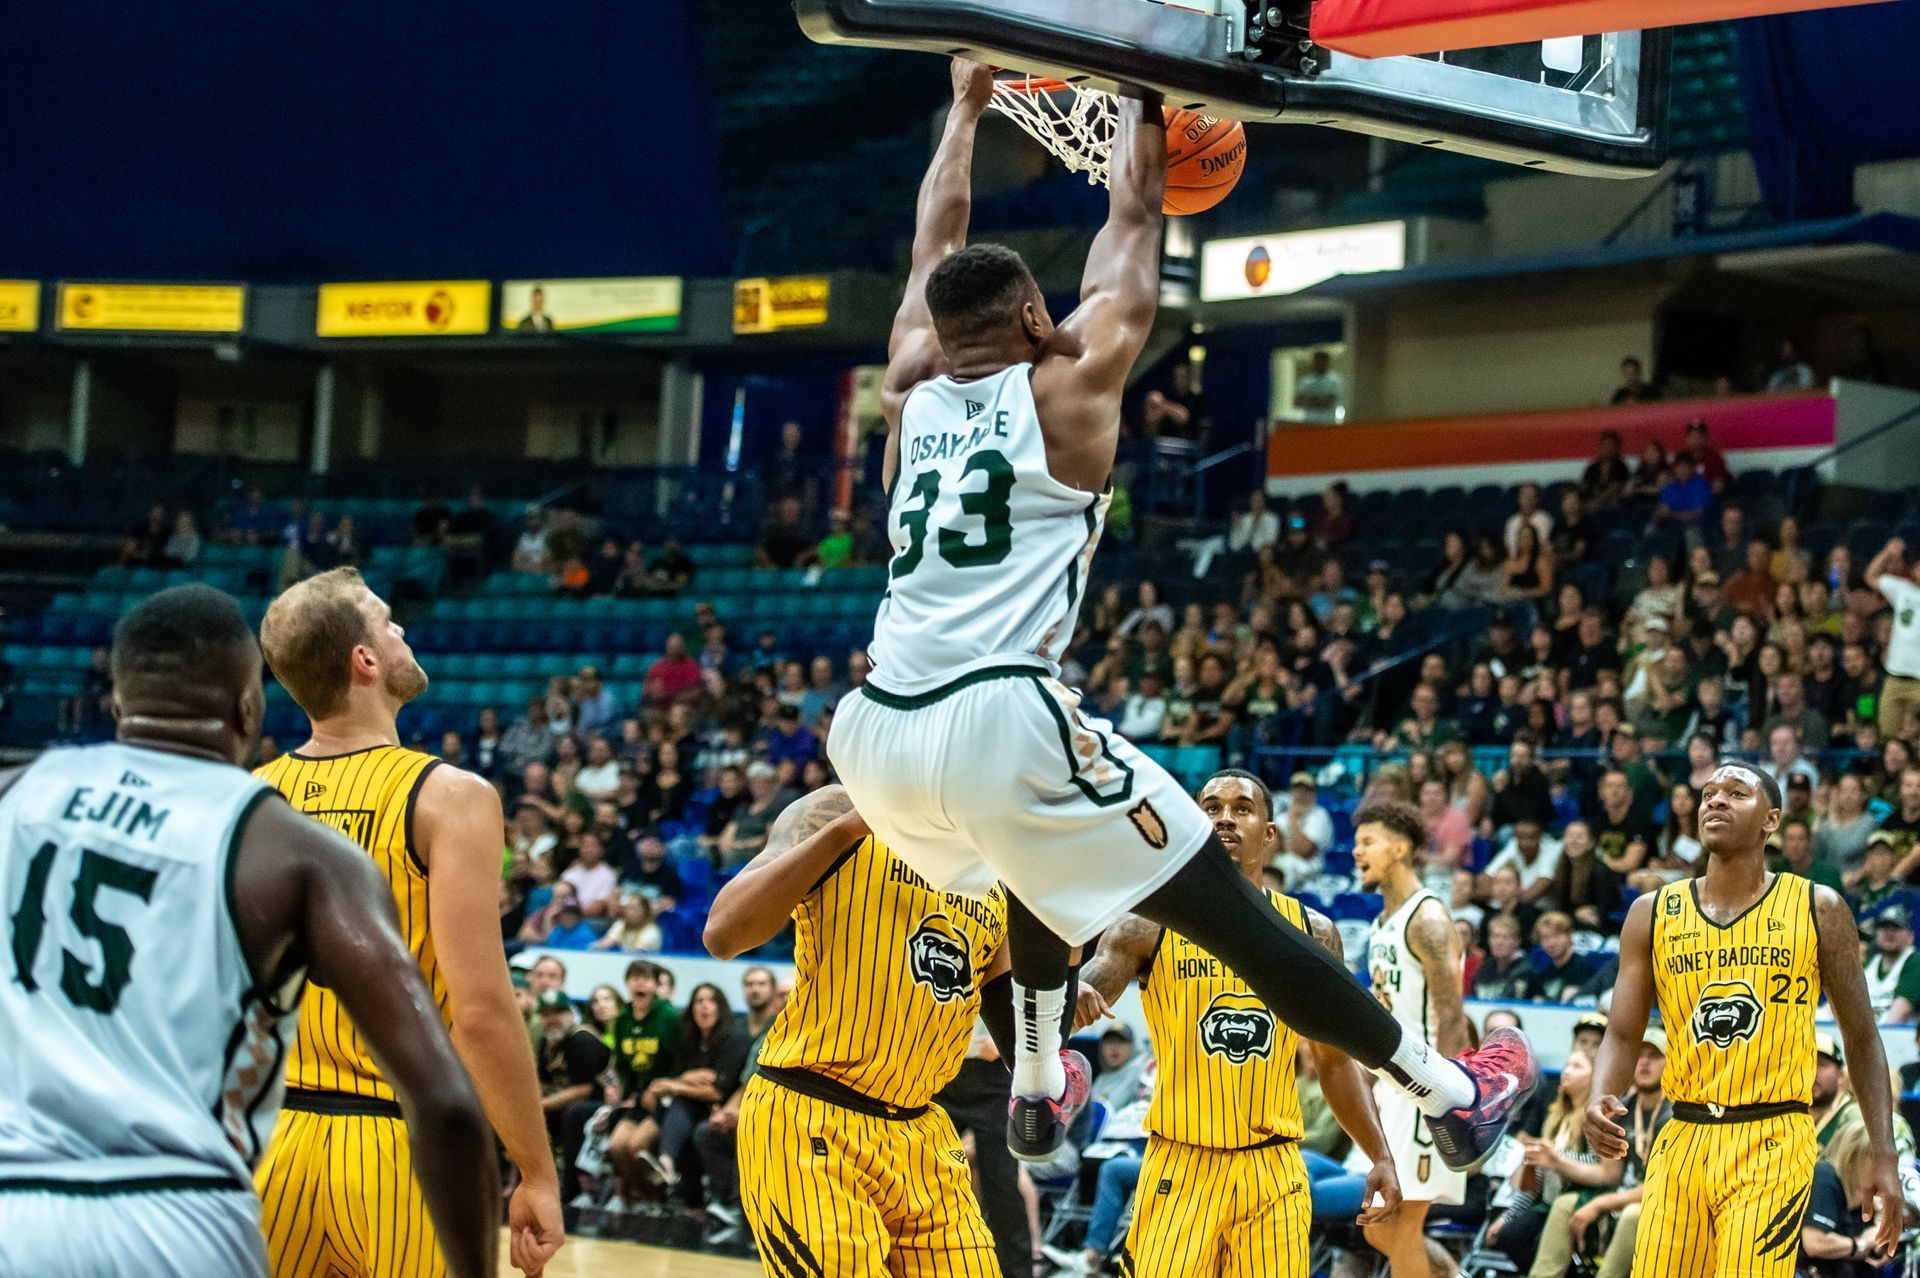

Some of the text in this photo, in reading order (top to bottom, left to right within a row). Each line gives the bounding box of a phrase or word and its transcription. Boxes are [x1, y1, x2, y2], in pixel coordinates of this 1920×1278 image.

[911, 410, 1009, 466] OSAYNE
[892, 450, 1016, 580] 33
[63, 788, 171, 841] EJIM
[11, 841, 159, 1015] 15
[1668, 931, 1701, 943] betcris
[1667, 946, 1791, 975] HONEY BADGERS
[1769, 973, 1809, 1005] 22
